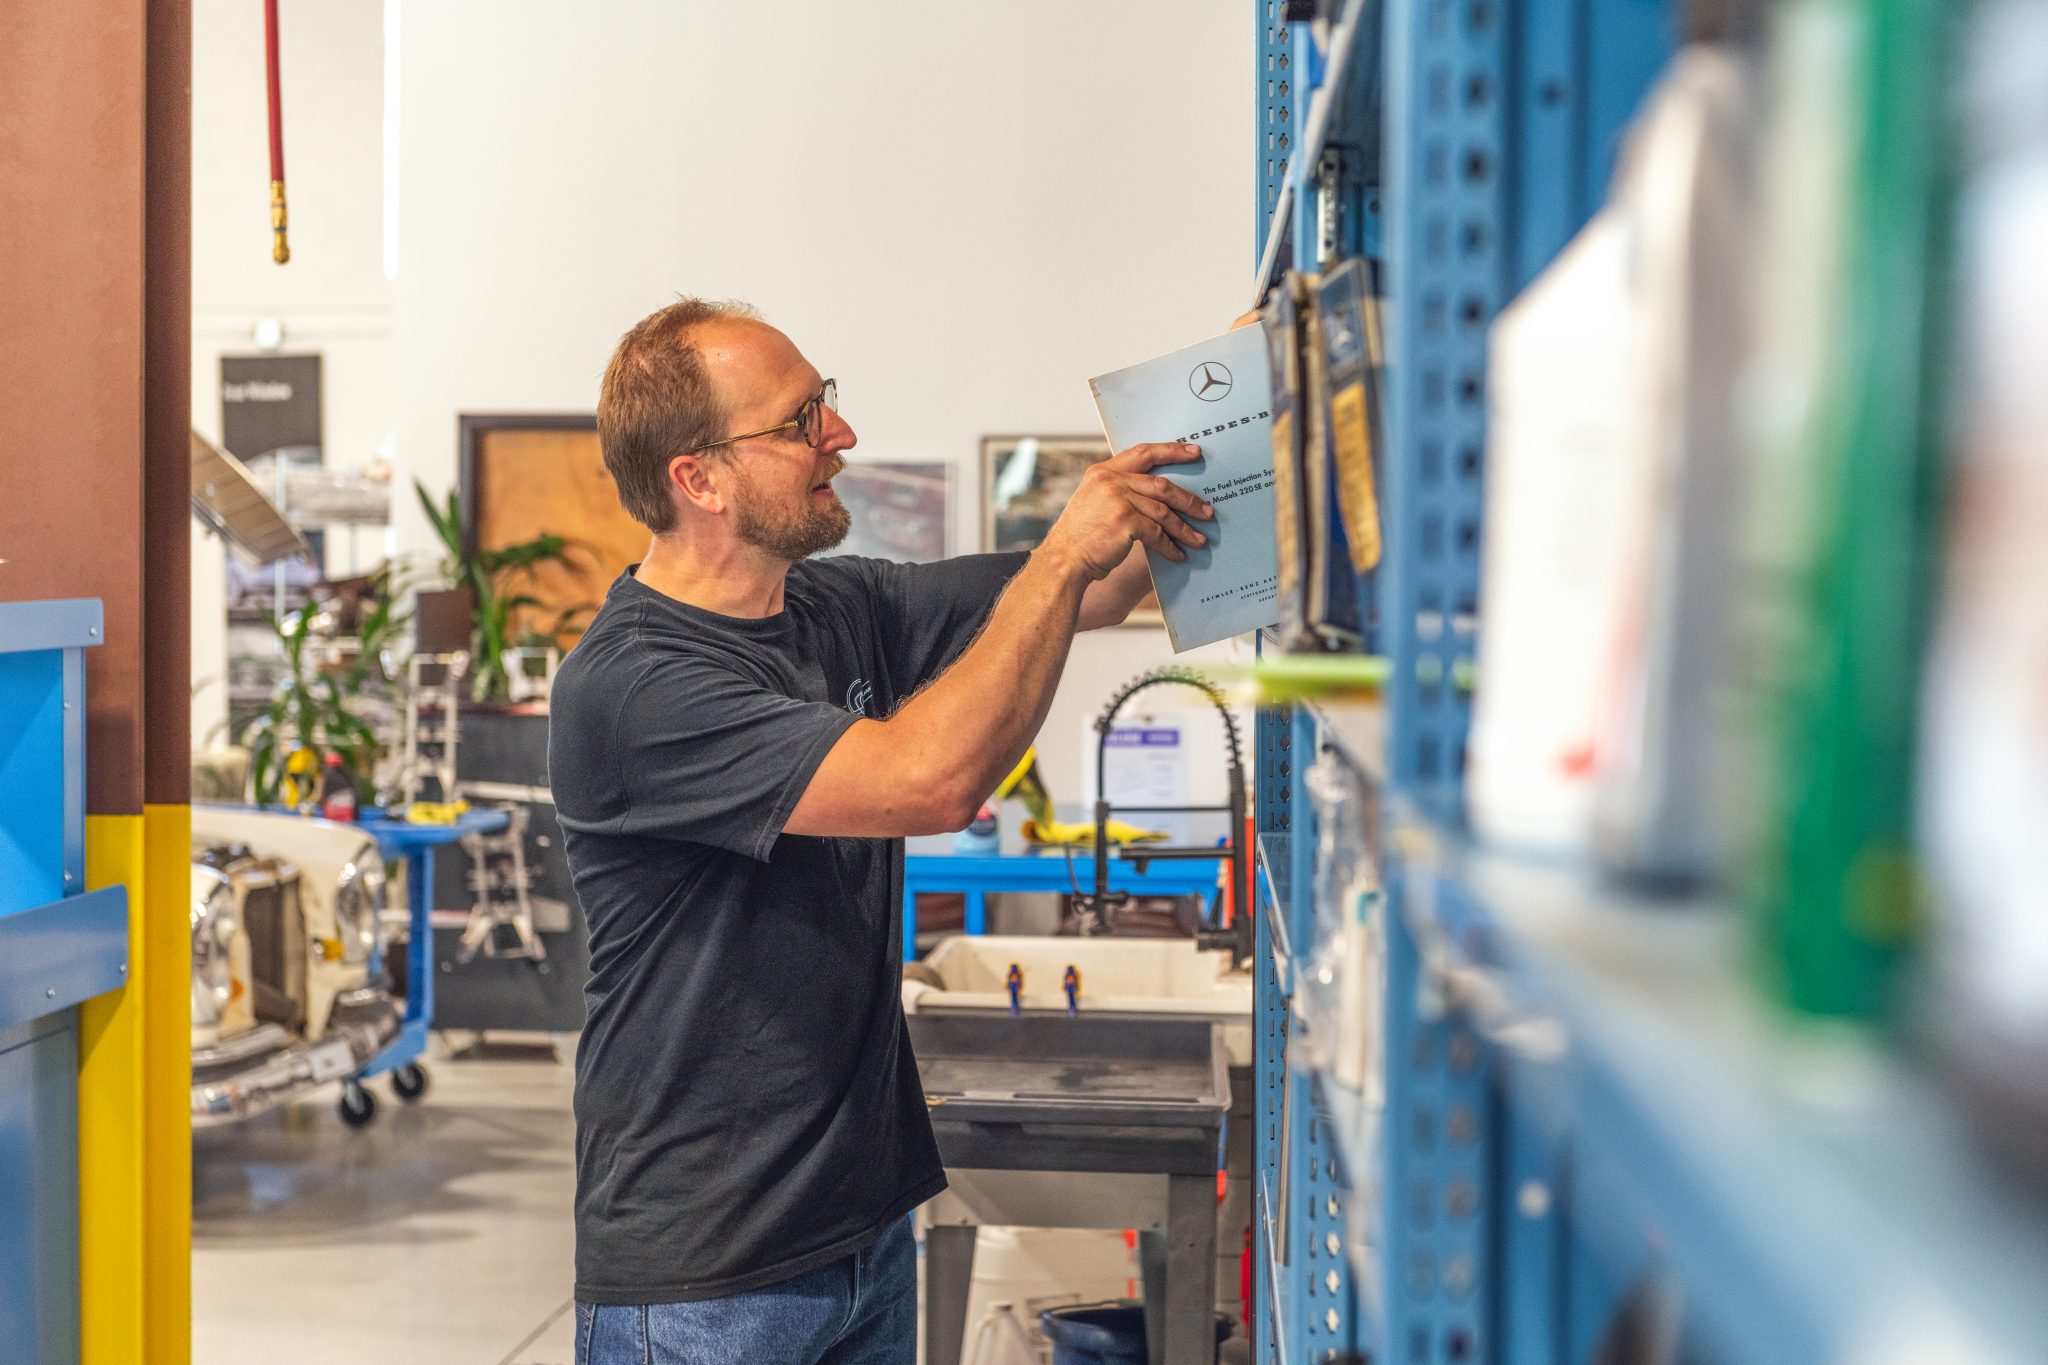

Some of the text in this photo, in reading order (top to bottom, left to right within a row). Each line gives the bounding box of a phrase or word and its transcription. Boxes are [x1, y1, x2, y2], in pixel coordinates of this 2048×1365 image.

[1176, 409, 1273, 444] RCEDES-B
[1203, 486, 1216, 495] The
[1217, 480, 1233, 491] Fuel
[1234, 473, 1262, 486] Injection
[1212, 490, 1238, 504] Models
